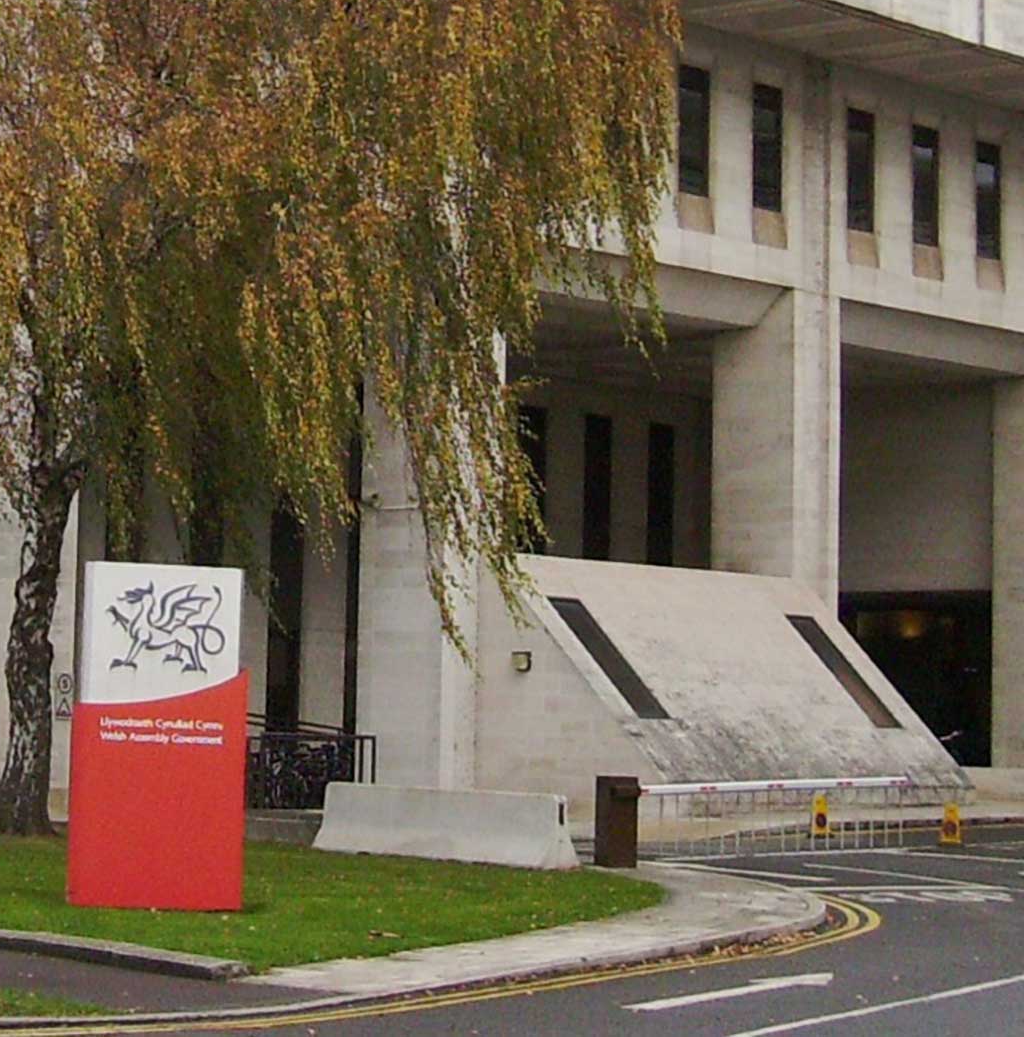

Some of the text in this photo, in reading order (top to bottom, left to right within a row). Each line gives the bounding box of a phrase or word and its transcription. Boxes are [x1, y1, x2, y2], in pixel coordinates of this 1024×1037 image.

[99, 730, 223, 745] Welsh Assembly Government
